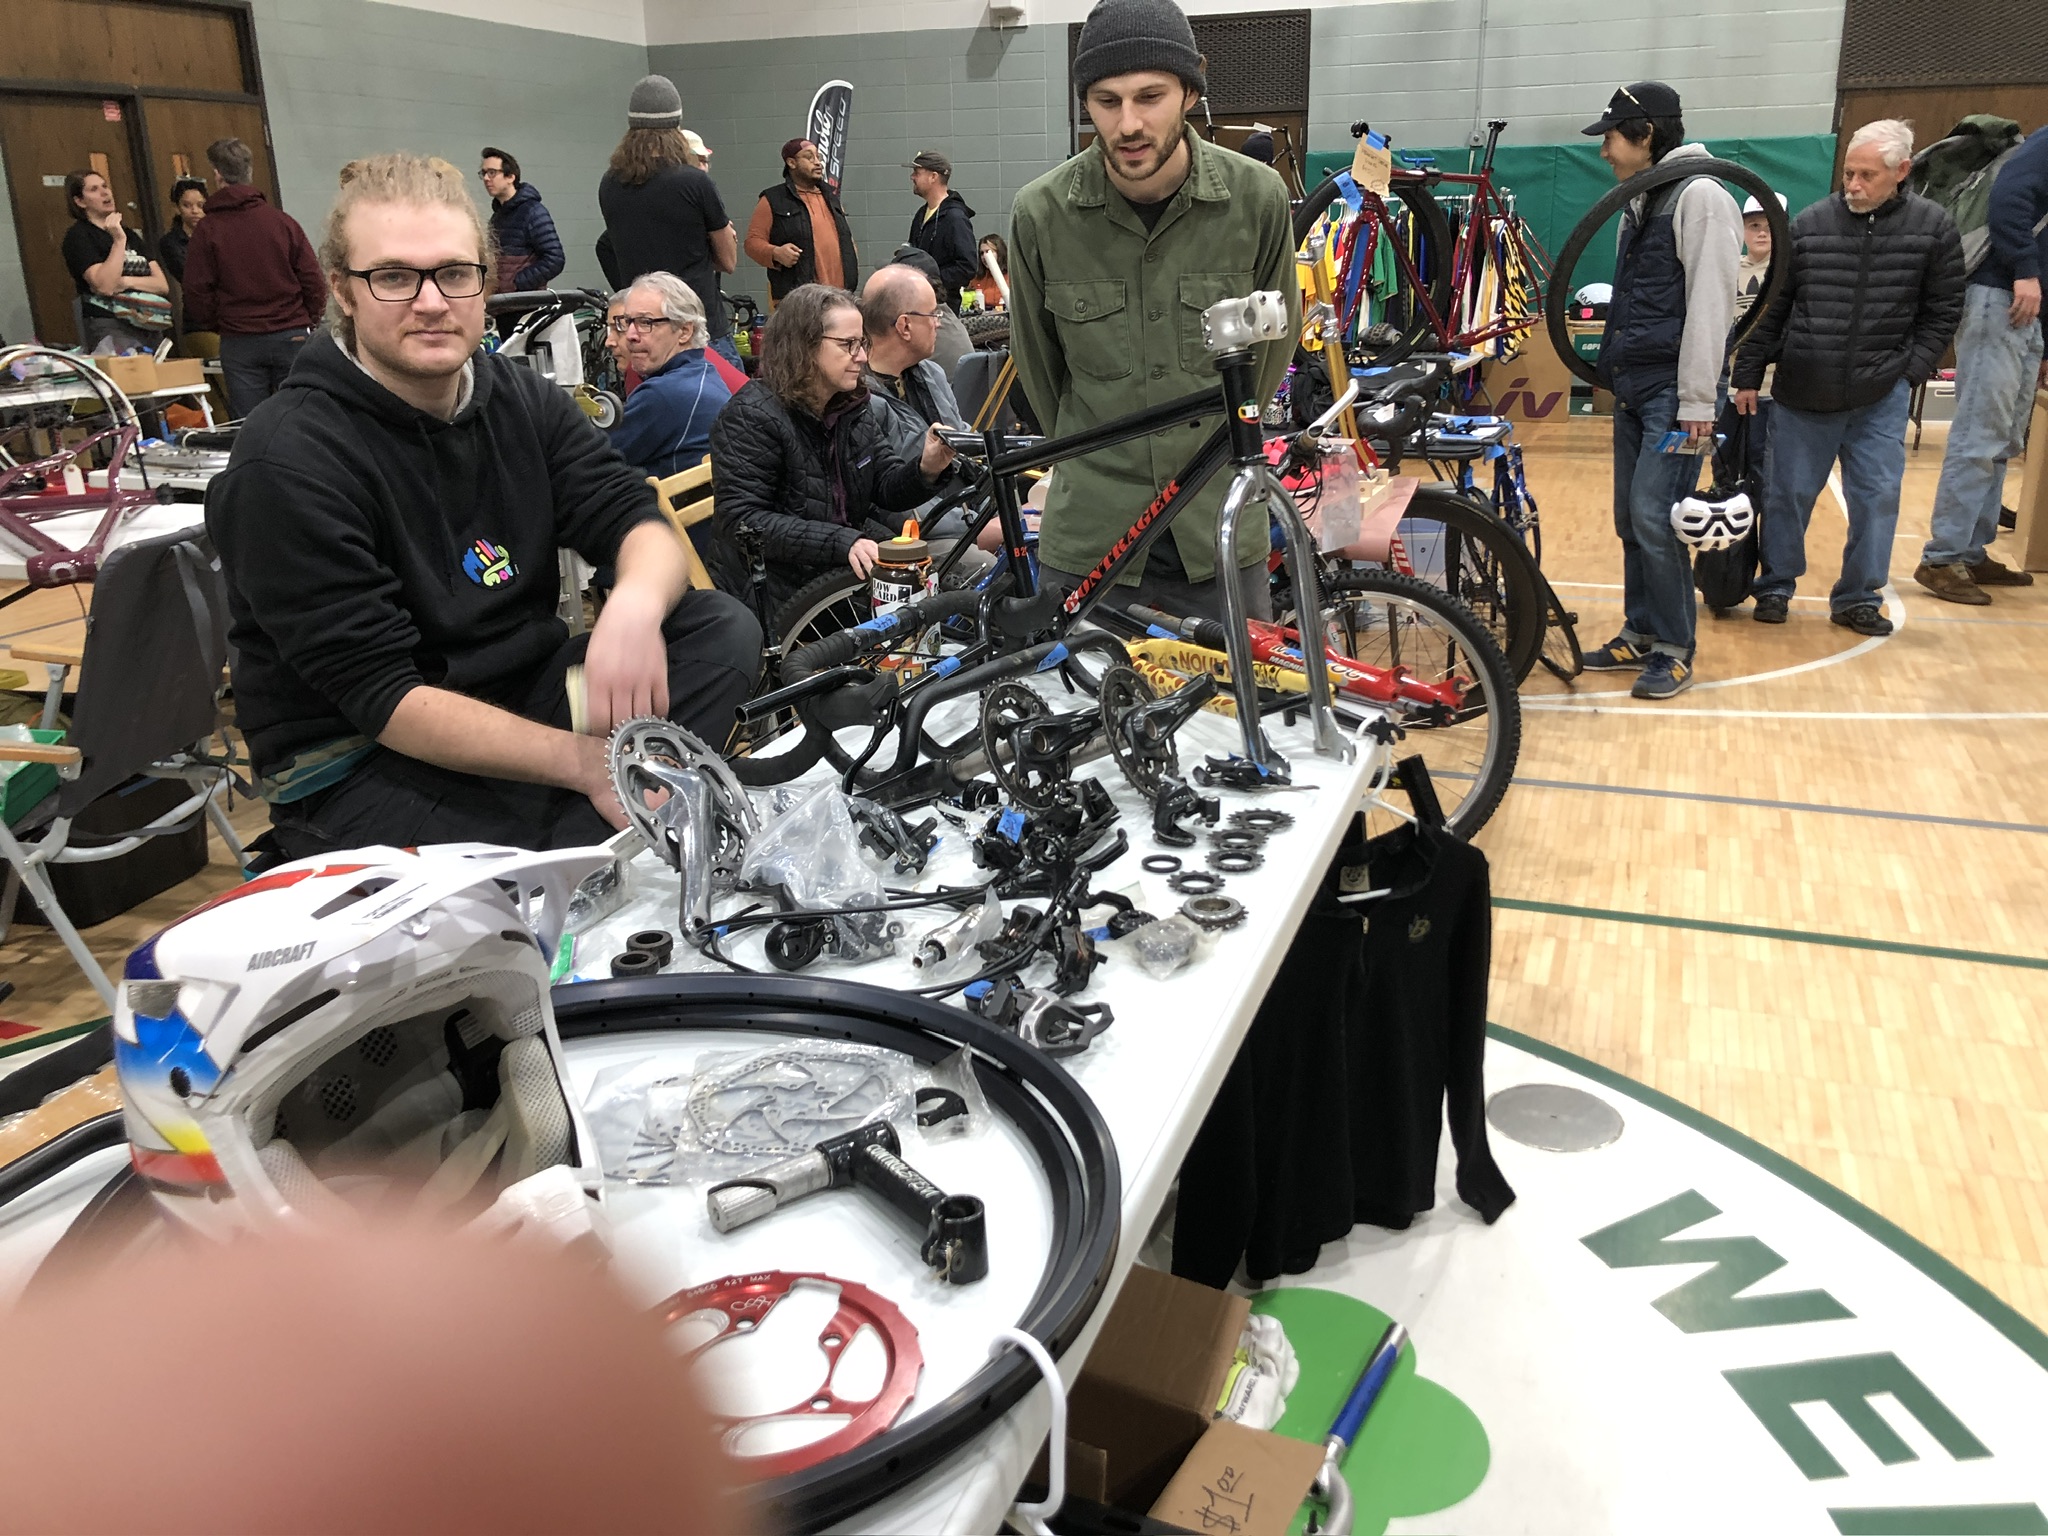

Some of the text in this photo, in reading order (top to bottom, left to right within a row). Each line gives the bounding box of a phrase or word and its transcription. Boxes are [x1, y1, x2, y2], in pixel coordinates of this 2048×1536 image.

[246, 940, 318, 972] AIRCRAFT
[724, 1277, 744, 1287] 42T
[749, 1273, 771, 1283] MAX
[1579, 1188, 2048, 1536] WE
